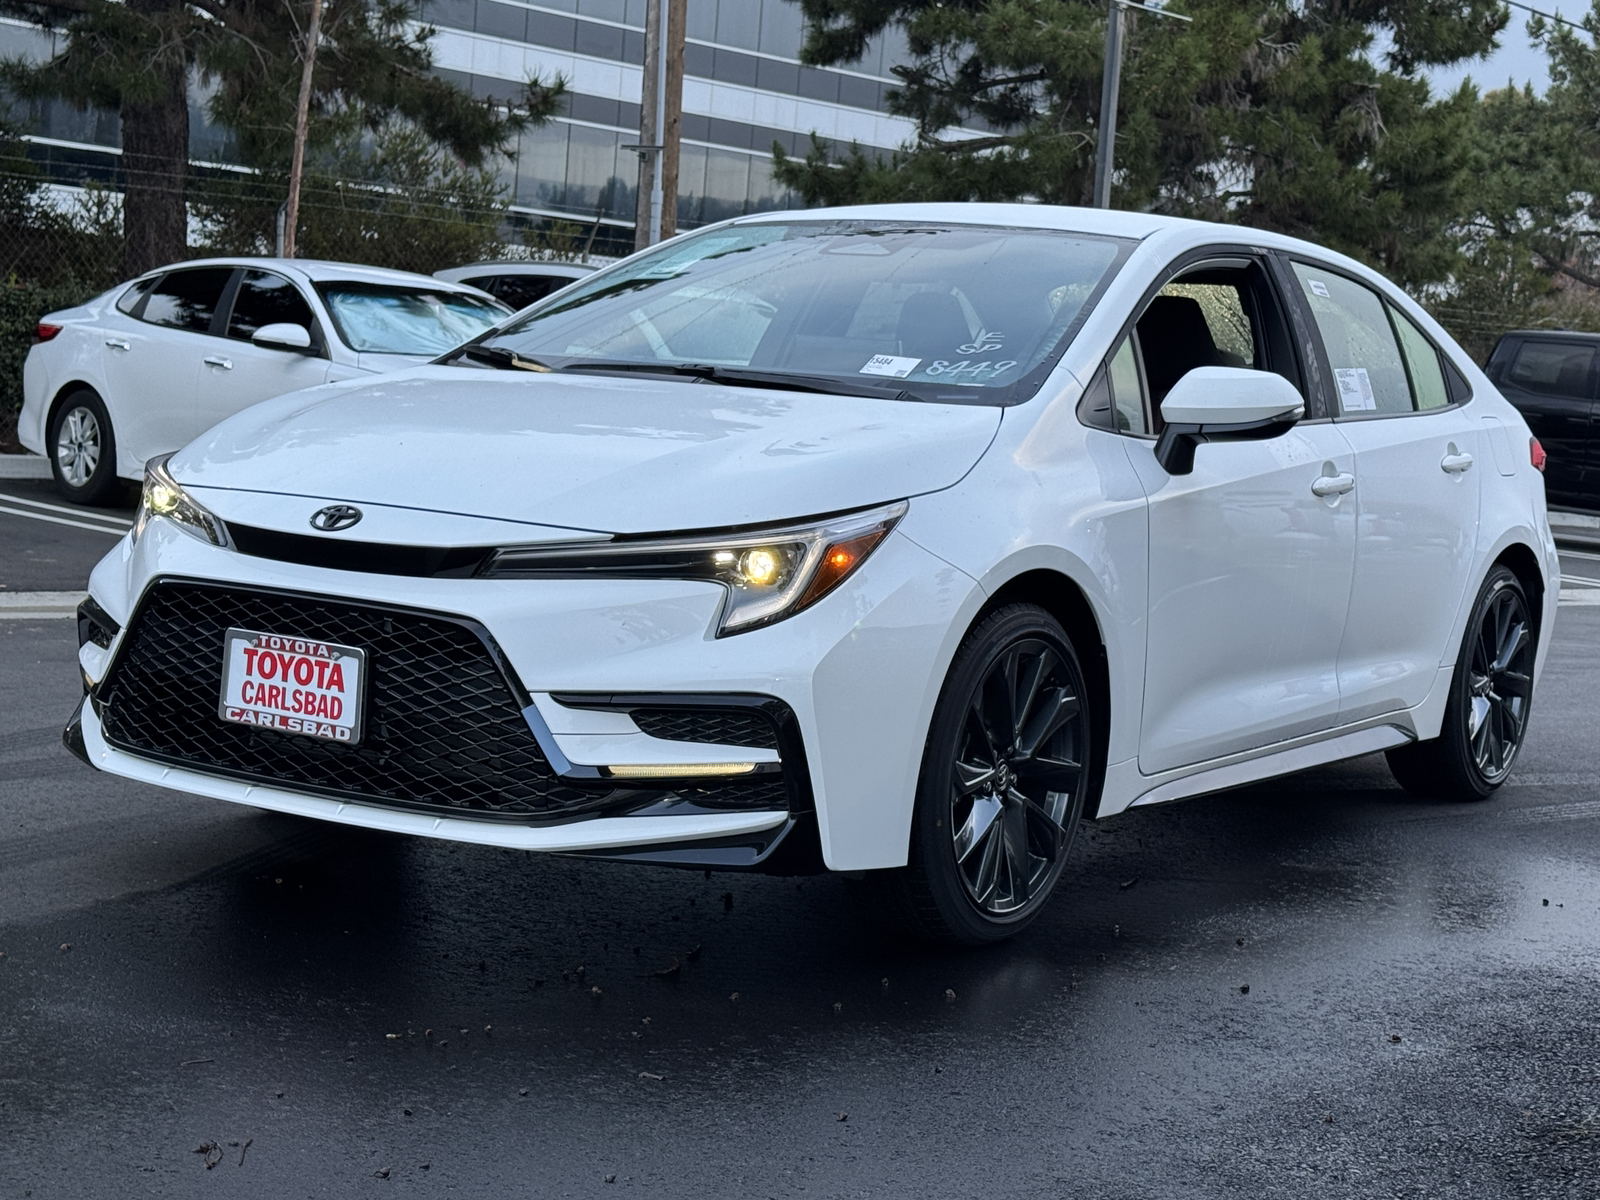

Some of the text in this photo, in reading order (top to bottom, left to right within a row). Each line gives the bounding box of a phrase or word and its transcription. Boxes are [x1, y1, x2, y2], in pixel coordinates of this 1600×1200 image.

[925, 360, 1018, 378] 8449
[259, 635, 329, 657] TOYOTA
[243, 647, 345, 693] TOYOTA
[241, 680, 343, 720] CARLSBAD
[225, 707, 350, 741] CARLSBAD
